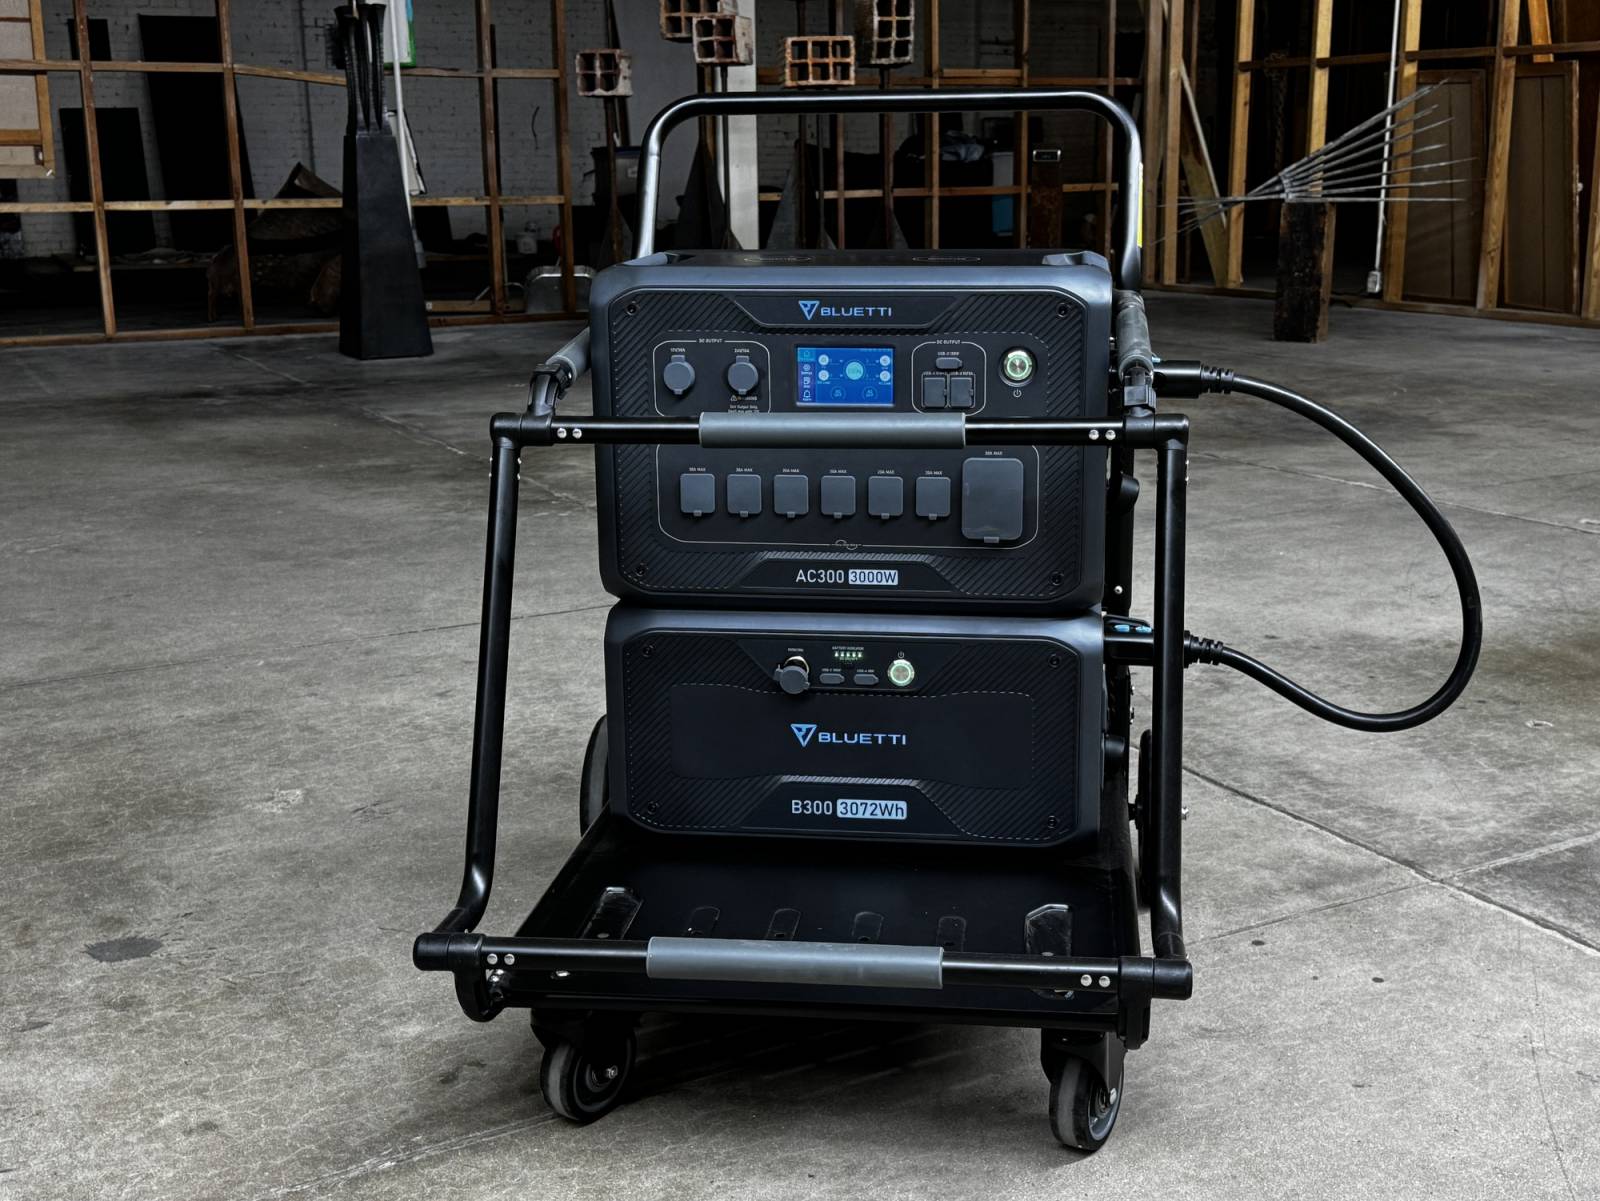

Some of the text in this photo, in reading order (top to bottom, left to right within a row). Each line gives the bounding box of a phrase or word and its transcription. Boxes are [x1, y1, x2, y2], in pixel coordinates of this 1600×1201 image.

[820, 306, 893, 317] BLUETTI
[795, 569, 897, 583] AC300 3000W
[818, 732, 907, 746] BLUETTI
[791, 799, 906, 818] B300 3072Wh
